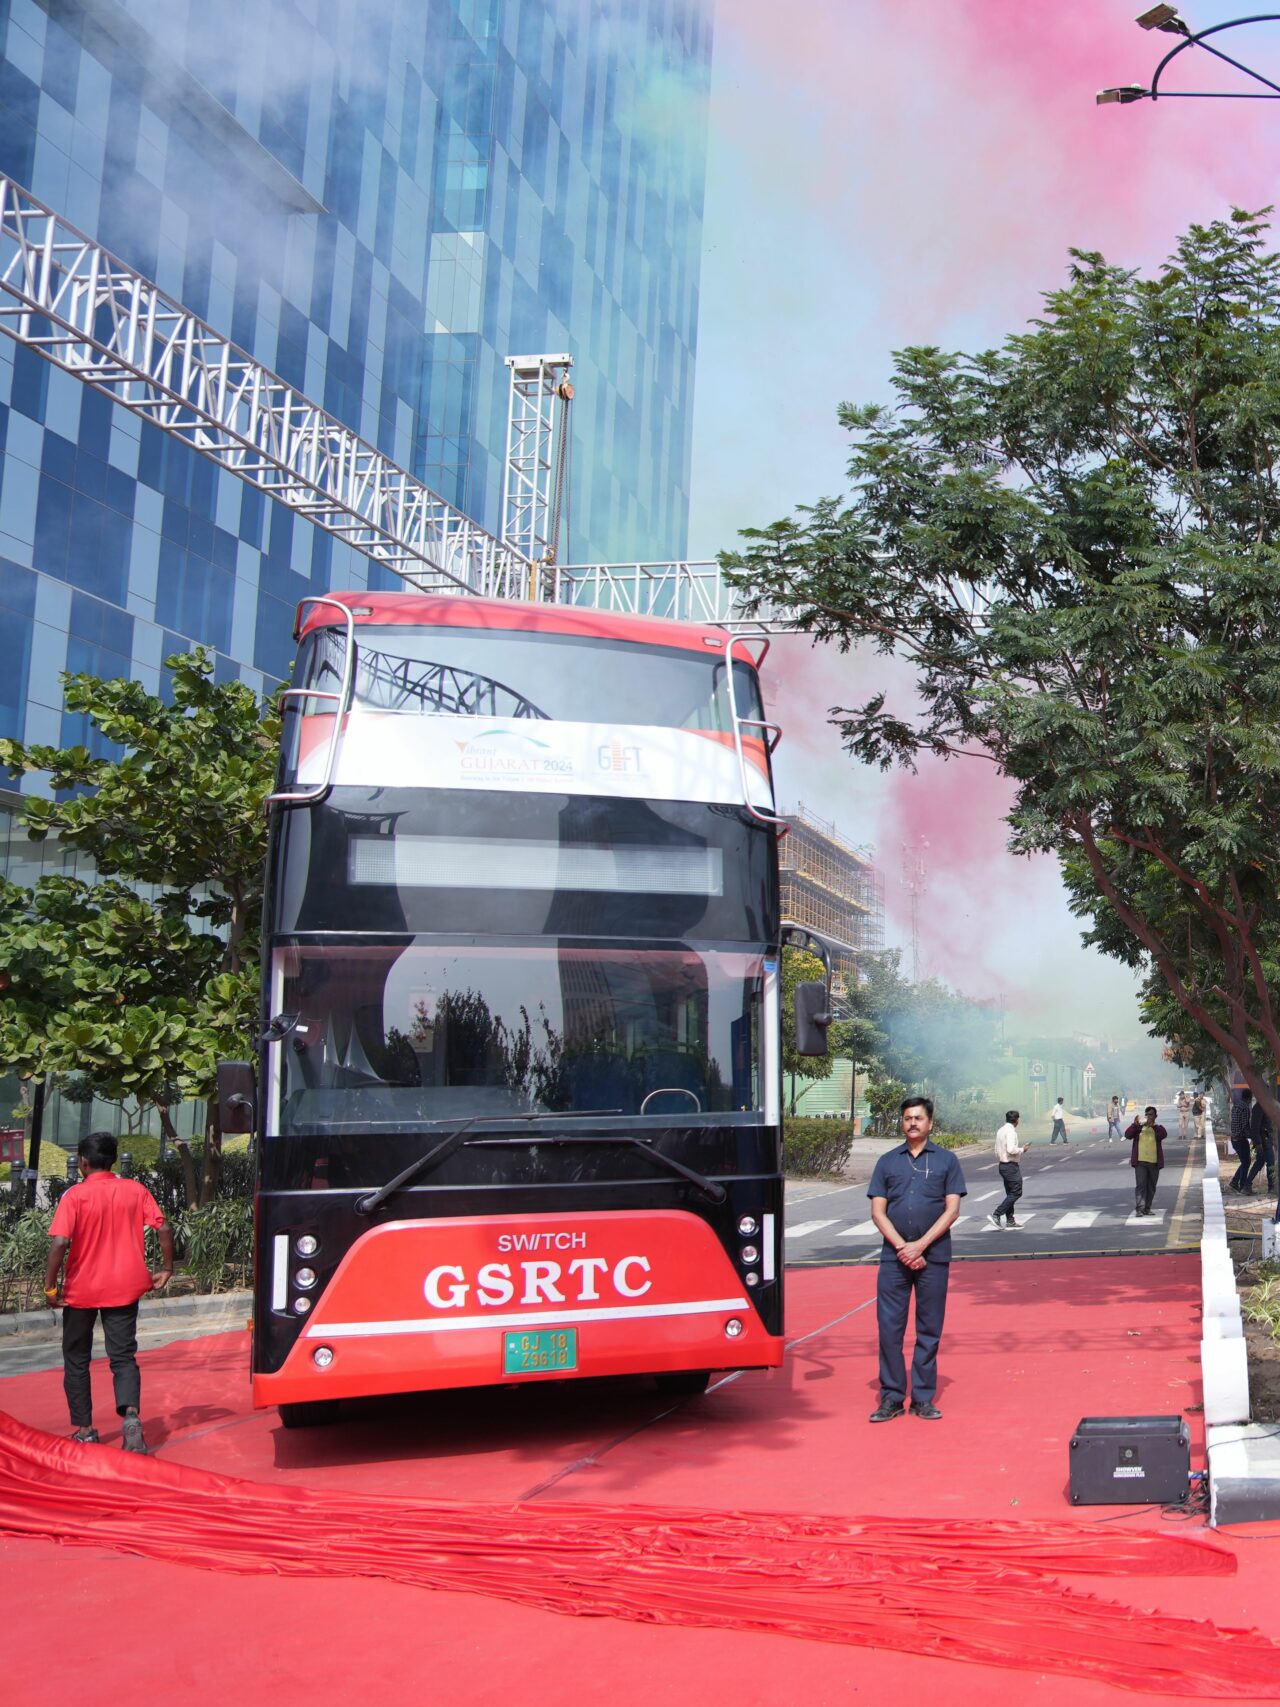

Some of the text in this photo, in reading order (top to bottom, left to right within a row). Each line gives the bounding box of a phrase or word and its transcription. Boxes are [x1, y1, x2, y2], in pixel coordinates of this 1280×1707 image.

[460, 756, 574, 772] GUJARAT 2024
[423, 1255, 653, 1309] GSRTC
[521, 1333, 567, 1351] GJ 18
[521, 1350, 568, 1368] Z9618
